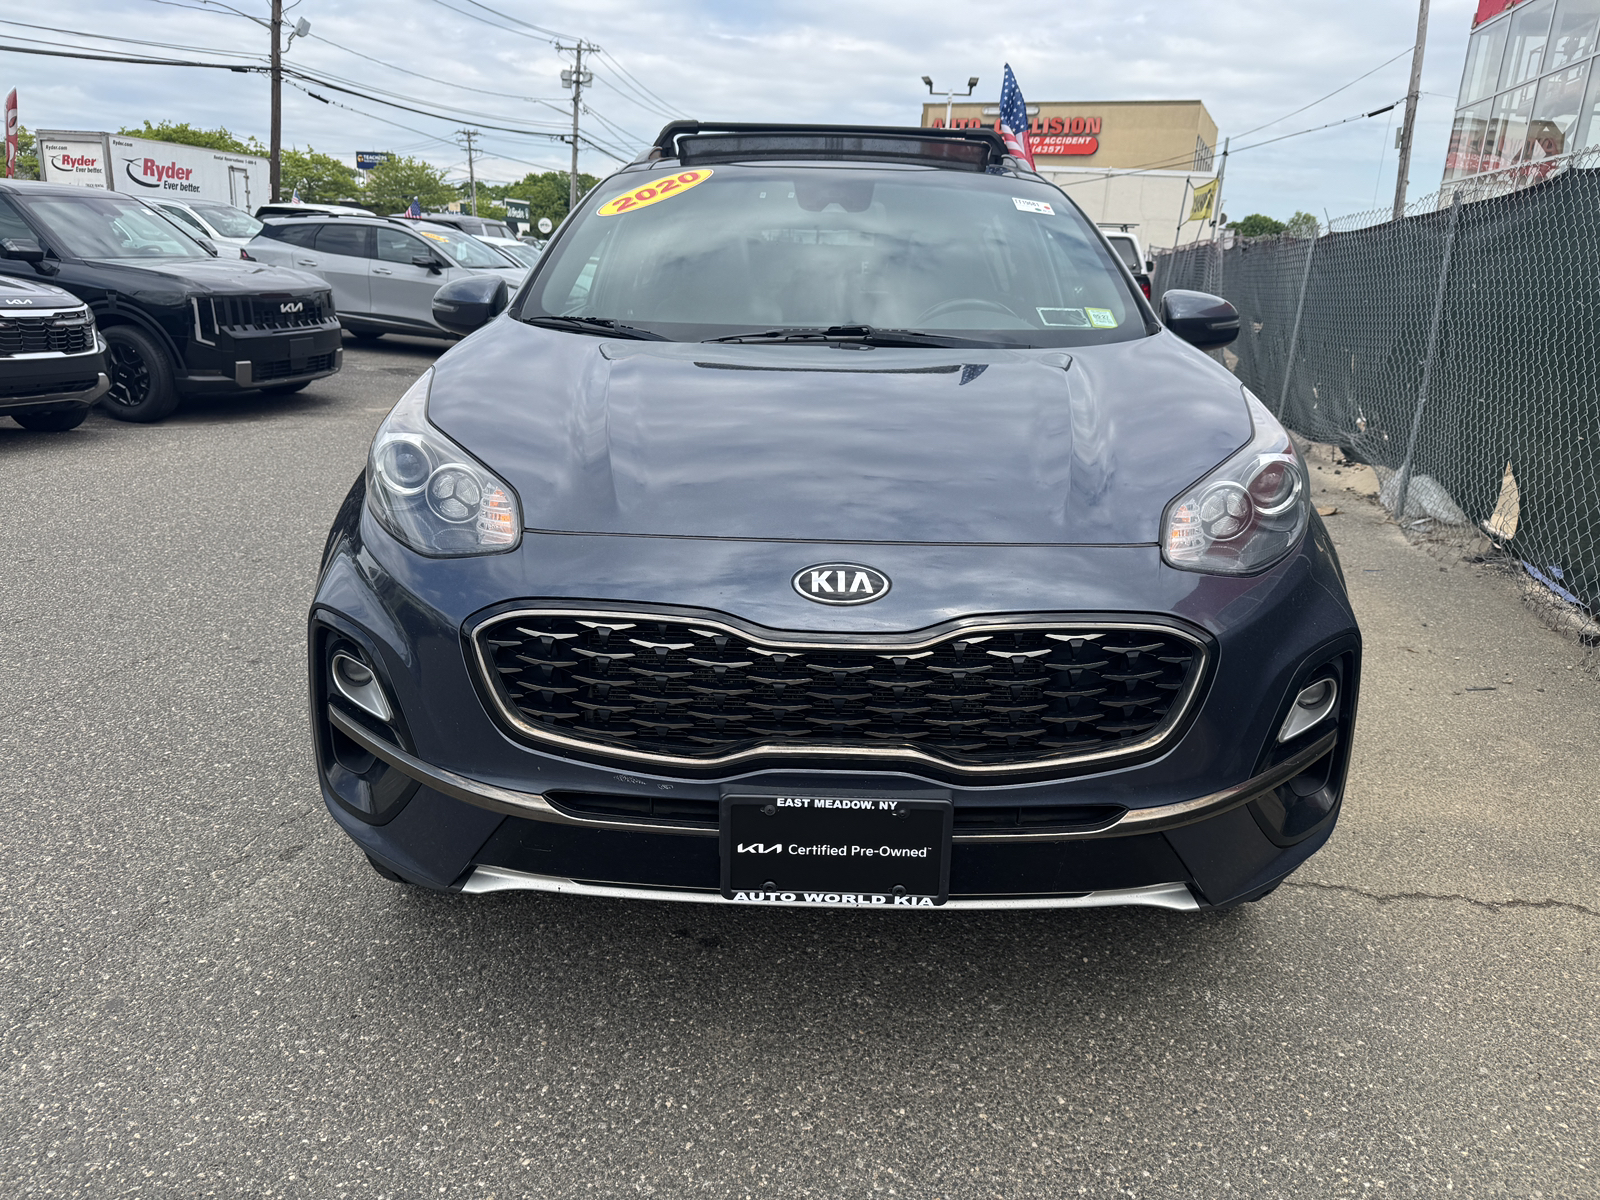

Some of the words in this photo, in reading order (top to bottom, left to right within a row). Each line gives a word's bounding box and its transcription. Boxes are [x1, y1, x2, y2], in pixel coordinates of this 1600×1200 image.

[994, 117, 1102, 135] CLISION
[1044, 136, 1092, 144] ACCIDENT
[1032, 145, 1064, 153] (4357)
[62, 154, 97, 168] Ryder
[143, 157, 193, 182] Ryder
[163, 180, 179, 191] Ever
[180, 181, 201, 193] better.
[612, 172, 700, 213] 2020
[811, 570, 874, 594] KIA
[776, 798, 811, 808] EAST
[879, 801, 898, 810] NY
[737, 842, 783, 854] KIA
[788, 843, 847, 856] Certified
[732, 891, 797, 902] AUTO
[803, 893, 886, 904] WORLD
[894, 896, 935, 906] KIA
